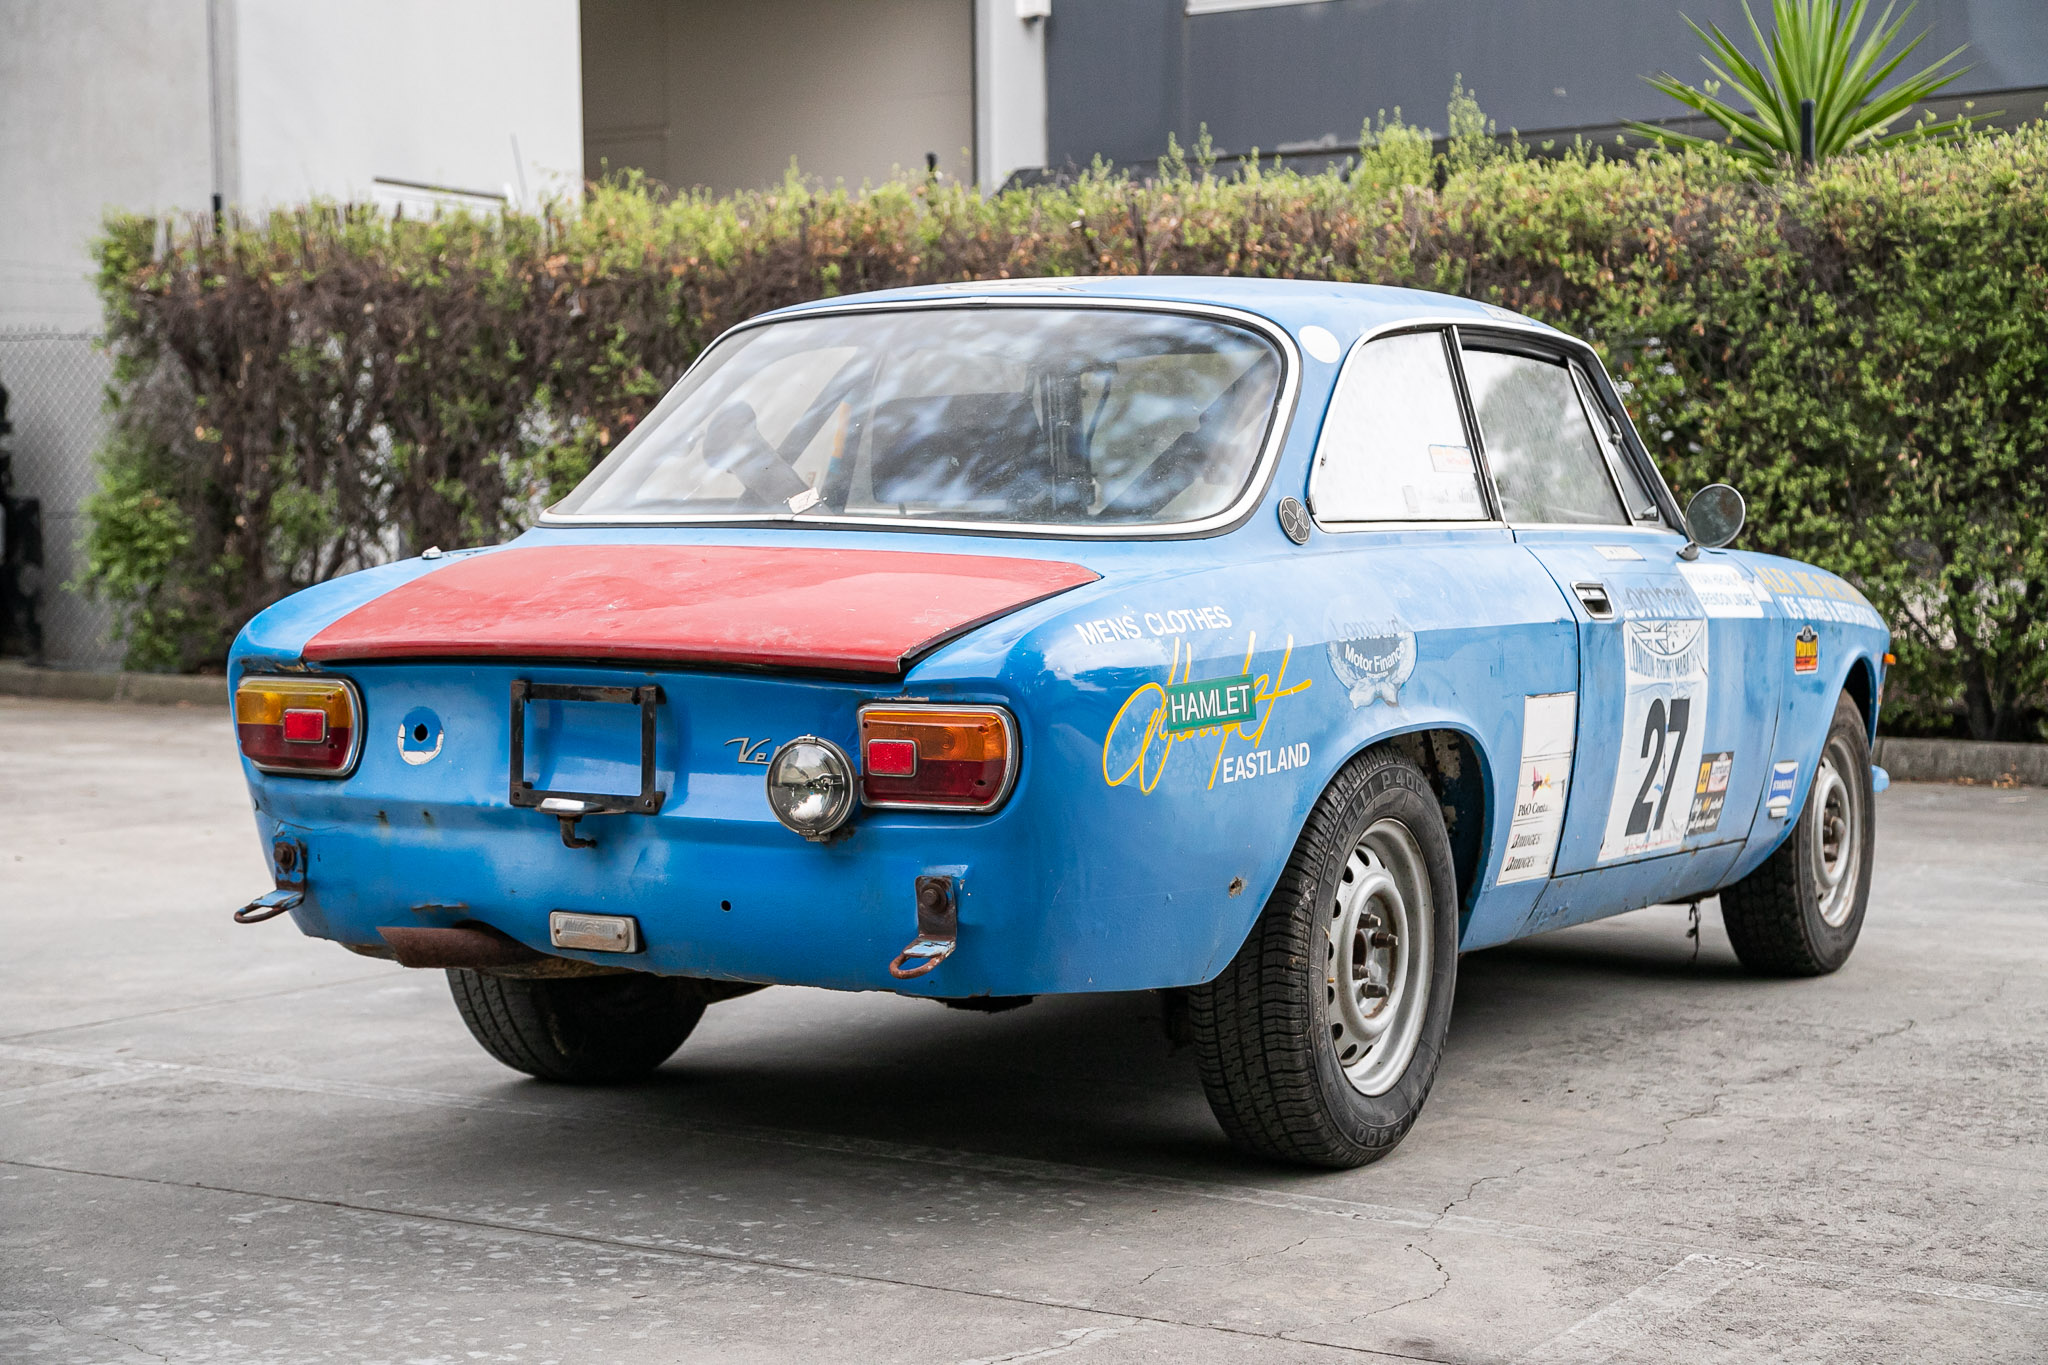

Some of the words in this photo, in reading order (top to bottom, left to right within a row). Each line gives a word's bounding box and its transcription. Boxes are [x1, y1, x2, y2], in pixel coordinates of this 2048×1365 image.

[1073, 615, 1142, 646] MENS
[1145, 605, 1232, 638] CLOTHES
[1344, 643, 1373, 672] Motor
[1373, 641, 1405, 672] Finance
[1170, 684, 1251, 723] HAMLET
[1222, 741, 1311, 783] EASTLAND
[1625, 697, 1690, 838] 27
[1517, 803, 1531, 817] P&O
[1324, 780, 1375, 887] PIRELLI
